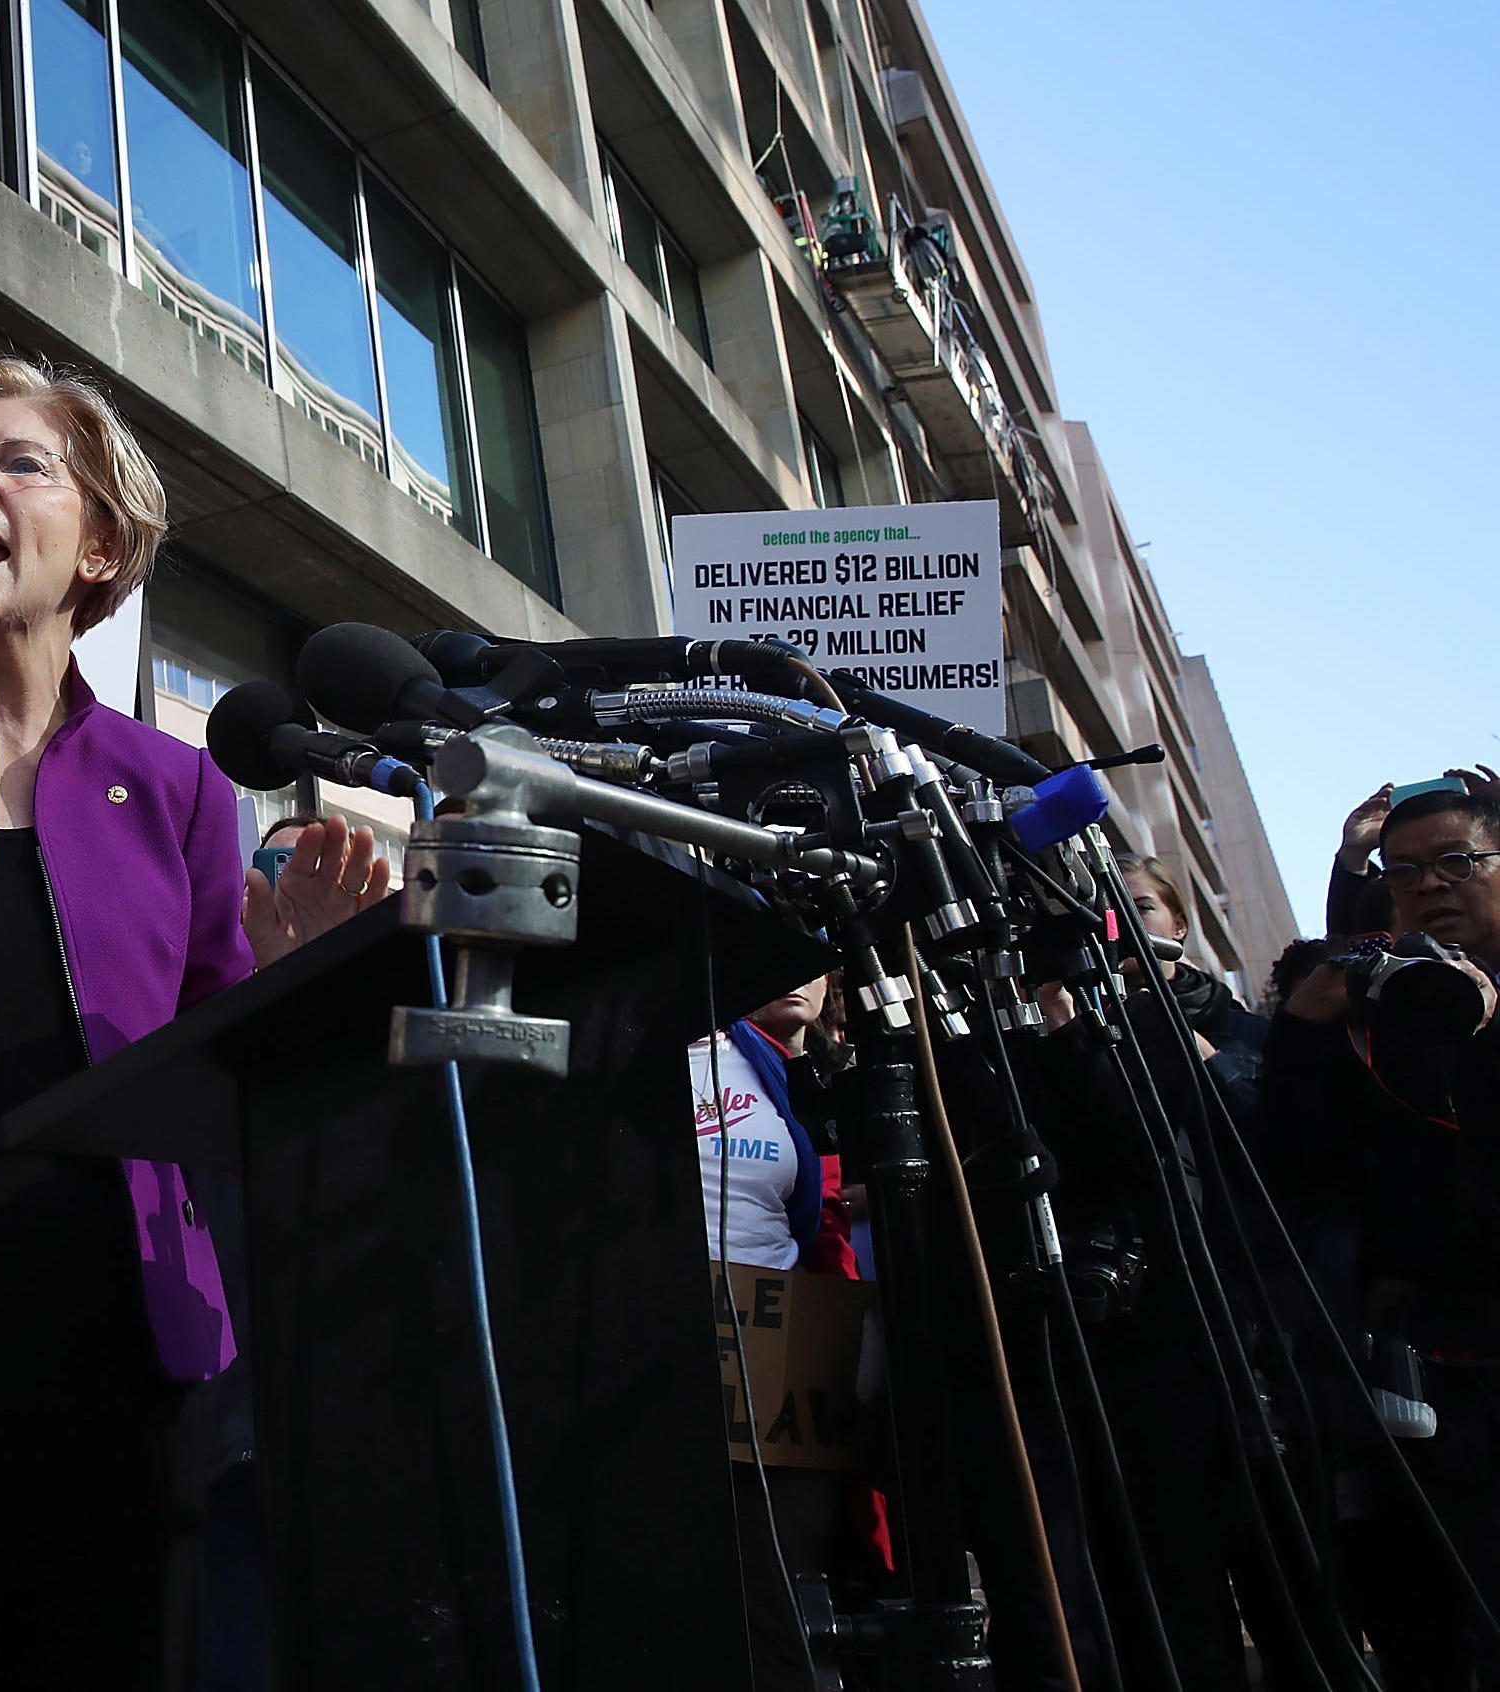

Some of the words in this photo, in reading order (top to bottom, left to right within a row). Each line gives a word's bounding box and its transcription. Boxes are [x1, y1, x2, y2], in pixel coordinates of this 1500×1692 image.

[763, 530, 806, 546] Defend
[810, 530, 830, 544] the
[834, 529, 880, 544] agency
[884, 526, 920, 541] that...
[695, 560, 827, 589] DELIVERED
[835, 553, 876, 586] $12
[885, 553, 979, 582] BILLION
[709, 599, 732, 624] IN
[740, 594, 870, 623] FINANCIAL
[879, 590, 965, 618] RELIEF
[827, 628, 926, 656] MILLION
[846, 660, 999, 692] ONSUMERS!
[710, 1137, 779, 1163] TIME
